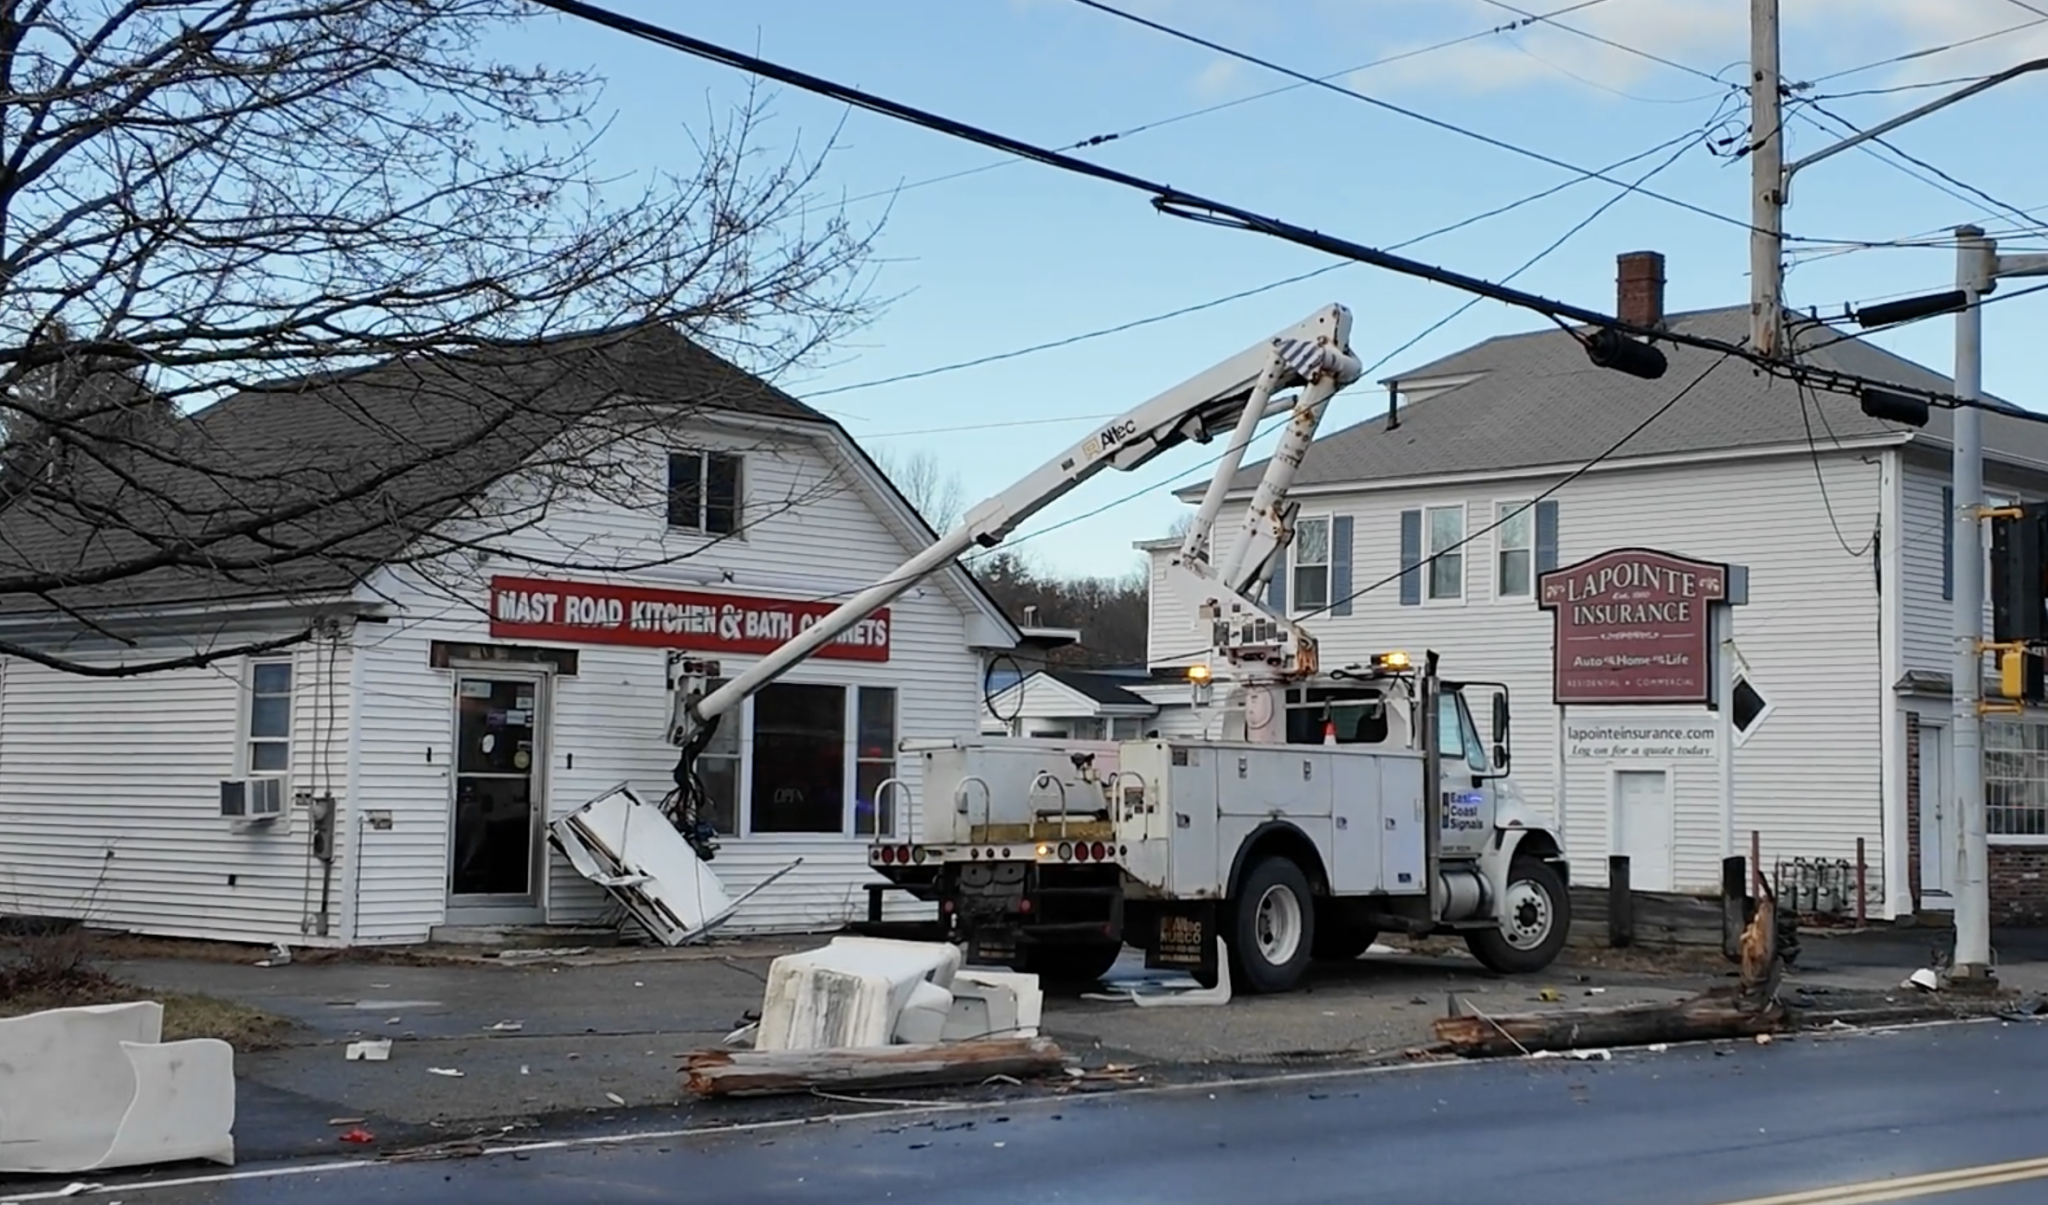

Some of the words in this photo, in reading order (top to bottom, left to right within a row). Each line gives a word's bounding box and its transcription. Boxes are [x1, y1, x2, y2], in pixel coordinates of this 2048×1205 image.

[1567, 563, 1696, 602] LAPOINTE
[498, 591, 558, 625] MAST
[564, 596, 623, 629] ROAD
[631, 600, 716, 635] KITCHEN
[718, 604, 744, 640] &
[745, 612, 793, 640] BATH
[1573, 602, 1690, 625] INSURANCE
[1573, 656, 1603, 667] Auto
[1616, 653, 1651, 666] Home
[1666, 653, 1689, 665] Life
[1567, 679, 1620, 687] RESIDENTIAL
[1636, 678, 1695, 687] COMMERCIAL
[1568, 726, 1714, 742] lapointeinsurance.com
[1572, 745, 1591, 757] Log
[1594, 747, 1608, 755] on
[1611, 745, 1629, 757] for
[1631, 747, 1639, 755] a
[1642, 746, 1674, 757] quote
[1677, 745, 1712, 756] today
[1450, 805, 1477, 817] Coast
[1450, 818, 1483, 831] Signals
